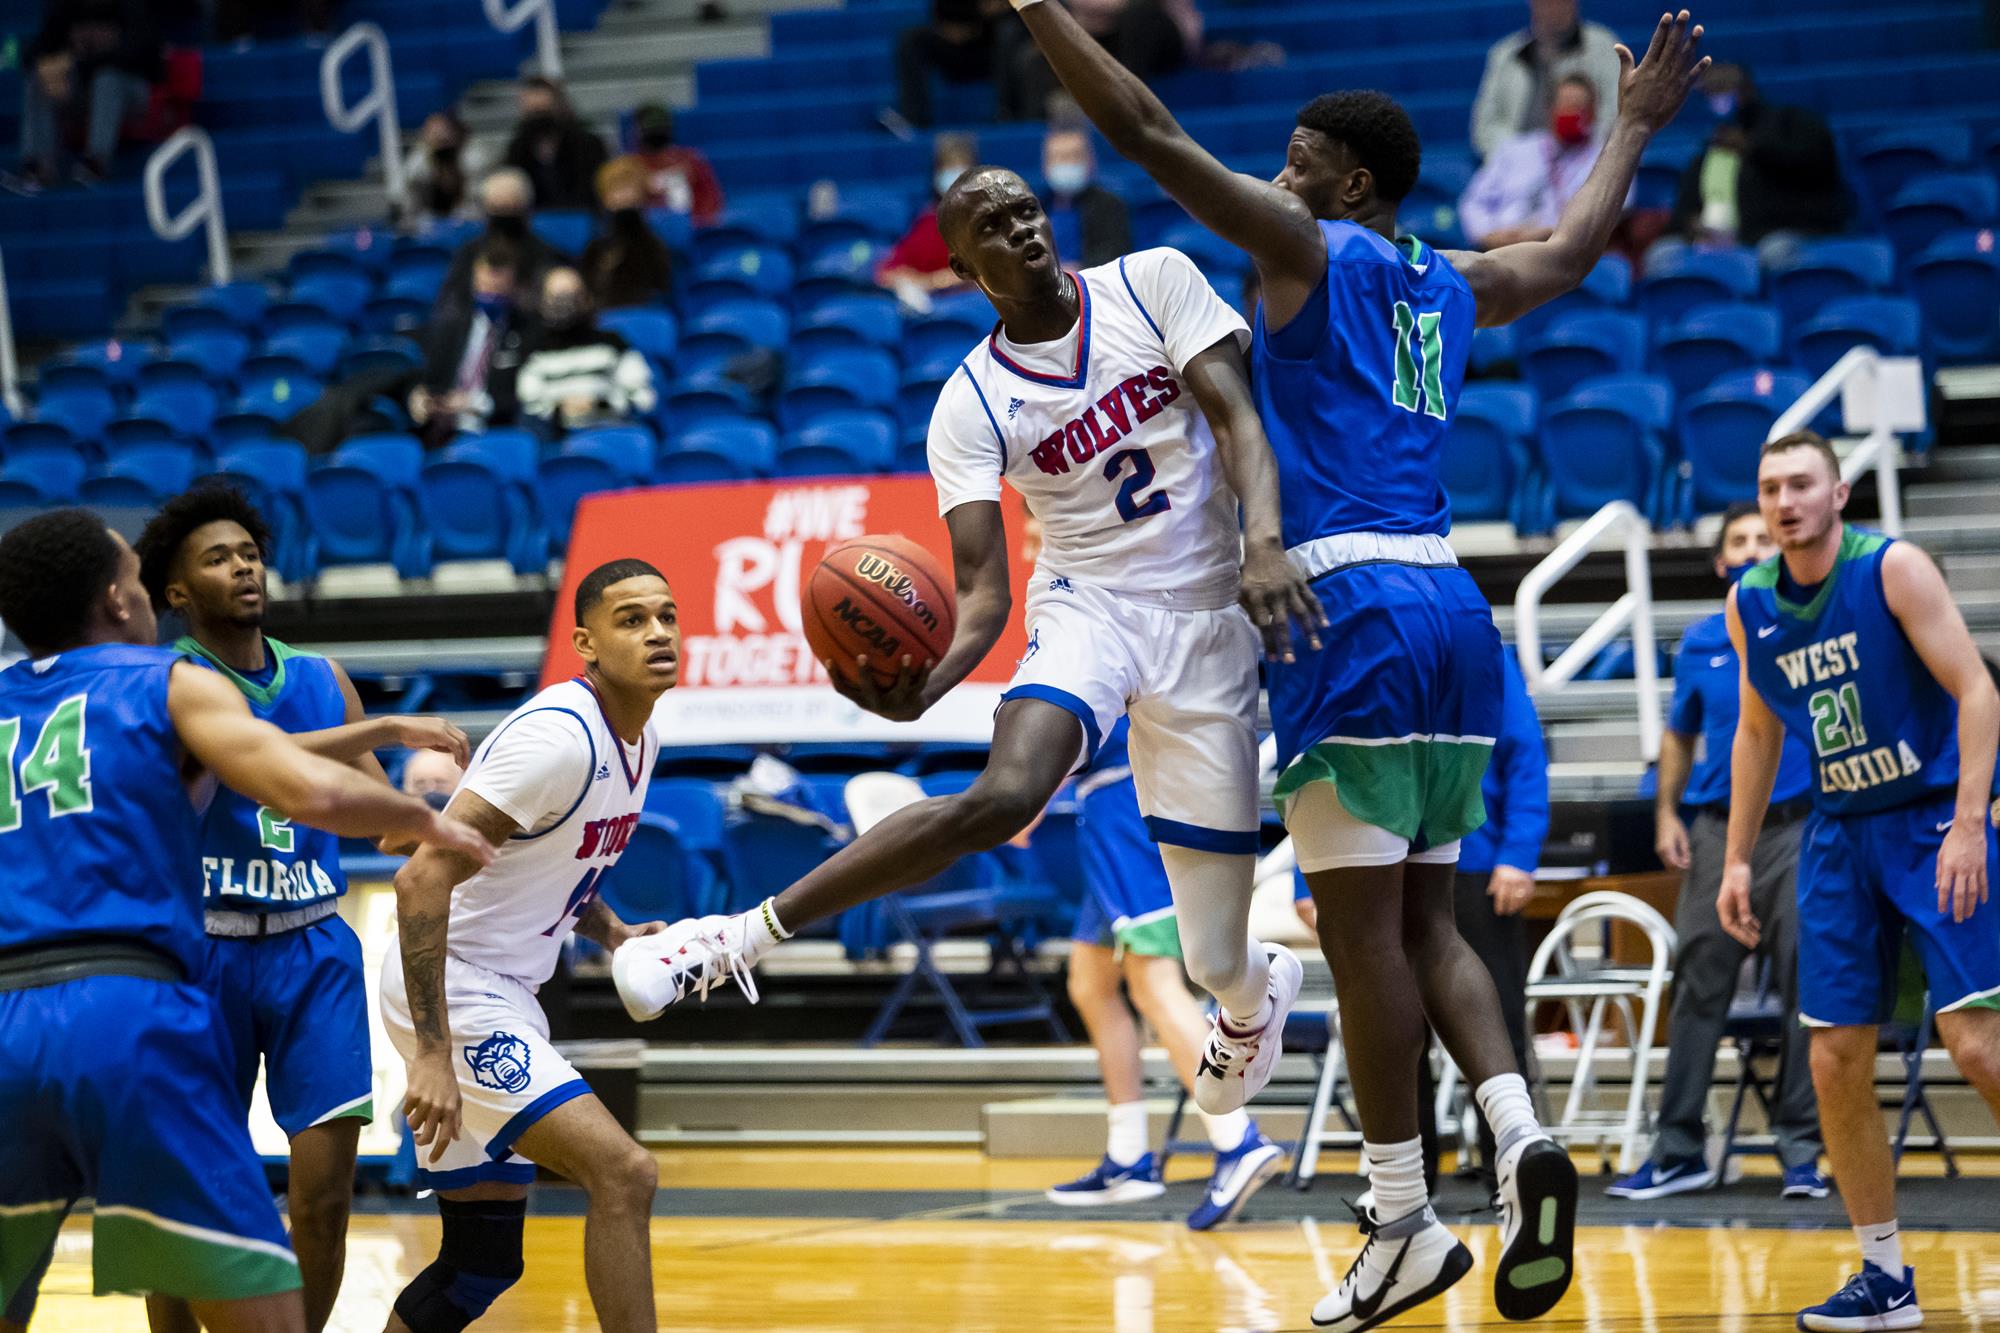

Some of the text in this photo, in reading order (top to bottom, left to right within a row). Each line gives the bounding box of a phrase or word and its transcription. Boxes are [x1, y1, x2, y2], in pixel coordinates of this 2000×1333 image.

[1392, 300, 1447, 421] 11
[1028, 364, 1182, 476] WOLVES
[1103, 448, 1171, 522] 2
[712, 536, 831, 634] RU
[855, 552, 938, 633] Wilson
[684, 632, 833, 687] TOGET
[832, 595, 901, 658] NCAA
[1775, 631, 1861, 690] WEST
[1808, 681, 1868, 758] 21
[0, 693, 94, 833] 14
[1819, 739, 1923, 794] LORIDA
[202, 856, 337, 901] FLORIDA
